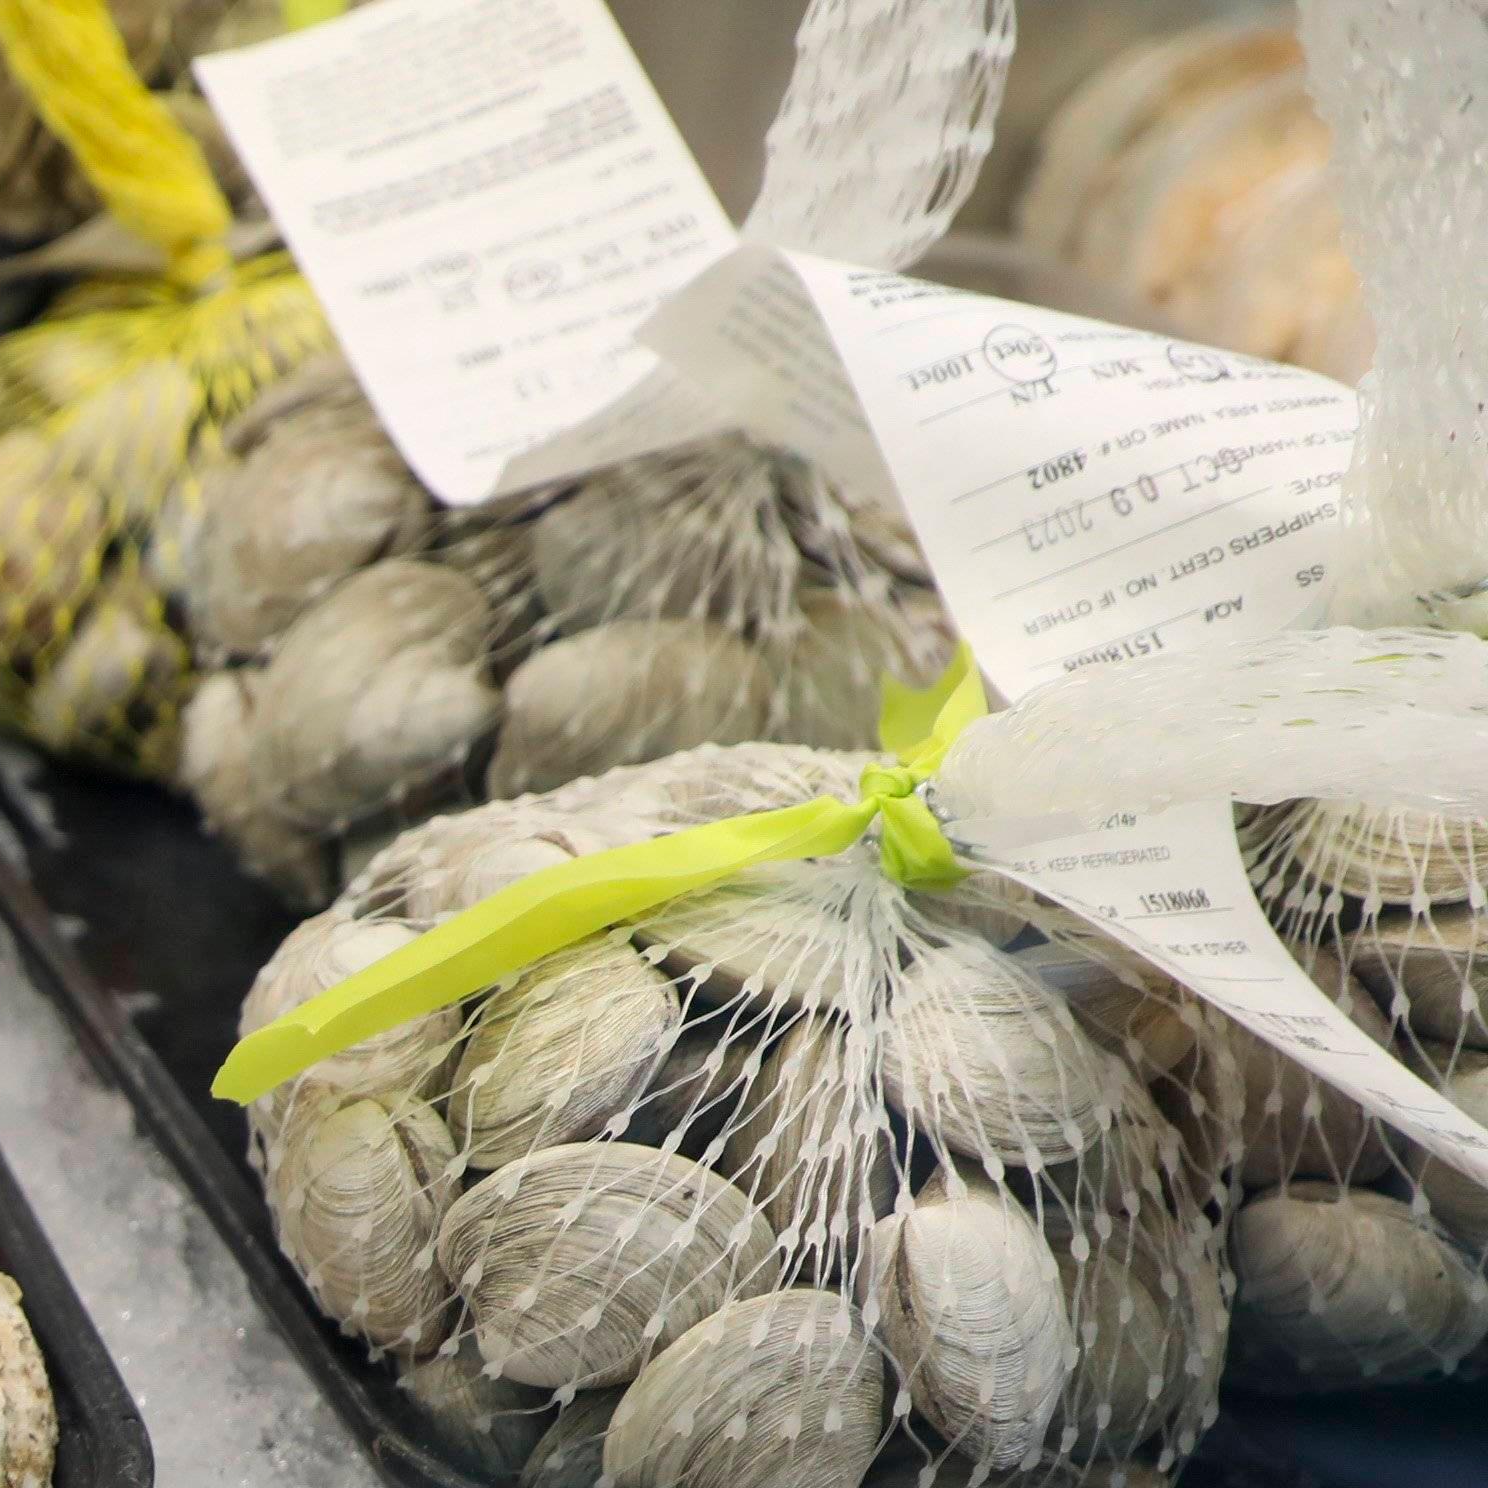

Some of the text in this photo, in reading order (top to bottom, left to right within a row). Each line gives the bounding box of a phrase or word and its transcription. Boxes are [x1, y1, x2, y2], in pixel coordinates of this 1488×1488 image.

[1117, 428, 1146, 449] OR
[1149, 413, 1206, 439] NAME
[1026, 448, 1088, 490] 4802
[1230, 501, 1337, 557] SHIPPERS
[1296, 564, 1325, 588] SS
[1098, 588, 1116, 611] IF
[1024, 599, 1093, 636] OTHER
[1048, 856, 1080, 873] KEEP
[1081, 845, 1171, 868] REFRIGERATED
[1139, 888, 1212, 915] 1518068
